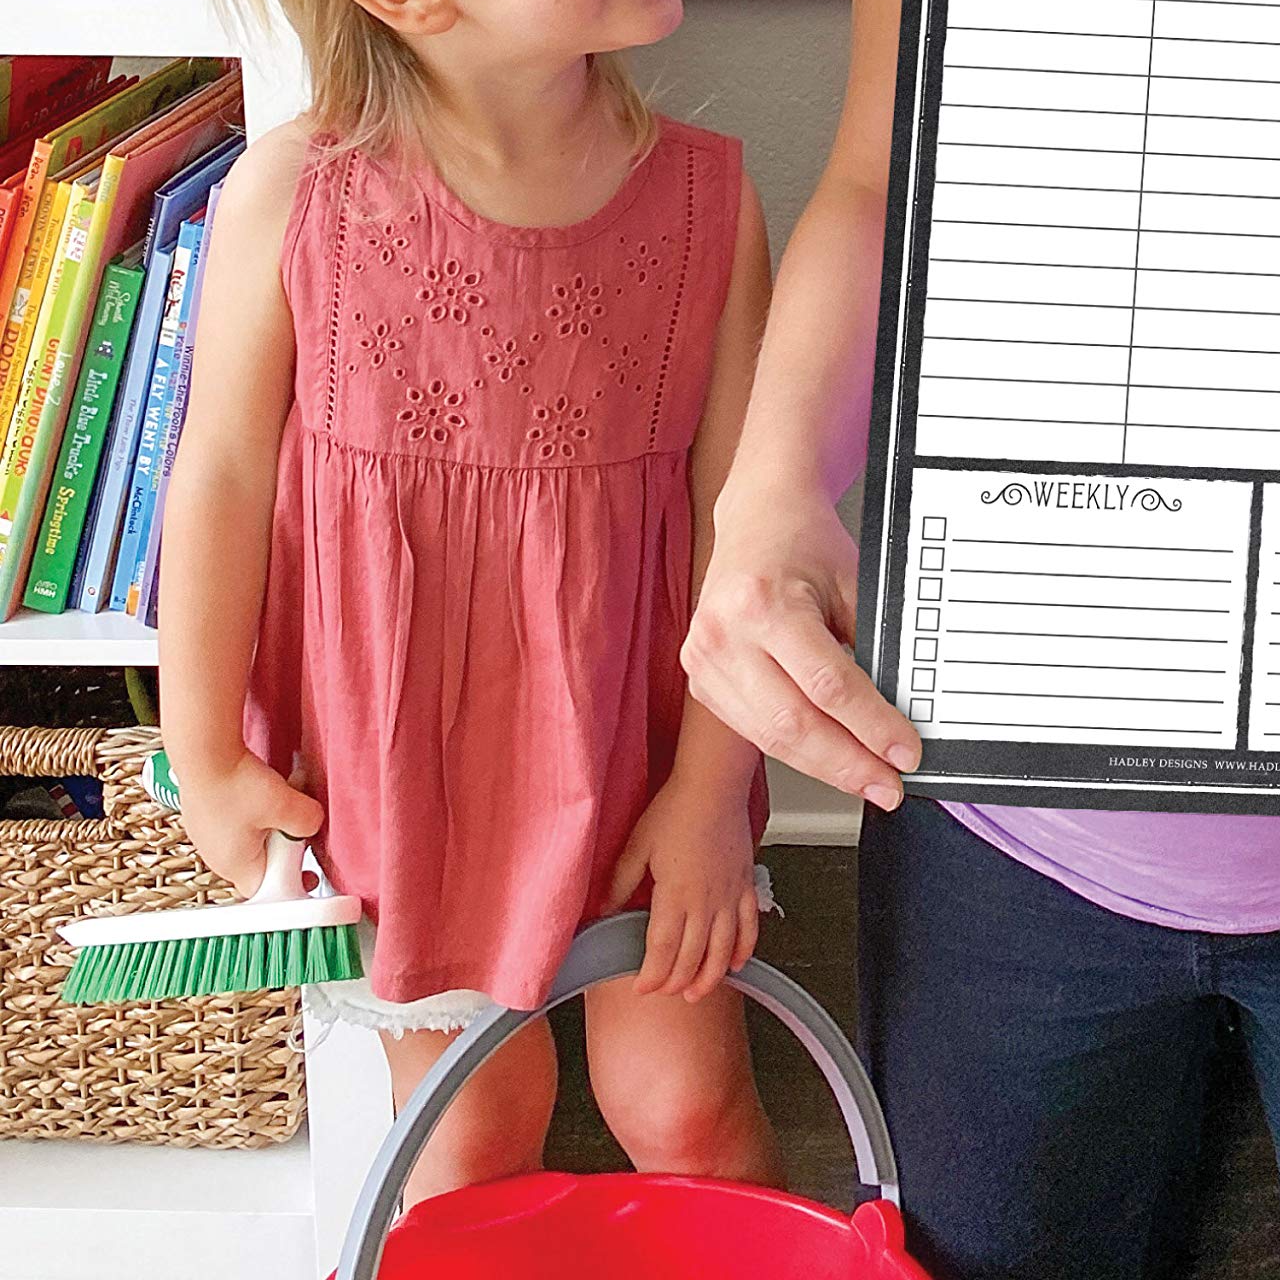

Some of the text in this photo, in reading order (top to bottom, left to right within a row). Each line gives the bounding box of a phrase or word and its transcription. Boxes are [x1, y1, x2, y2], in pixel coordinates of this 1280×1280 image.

[155, 357, 169, 369] A
[151, 374, 168, 400] FLY
[142, 406, 161, 451] WENT
[45, 369, 108, 555] Little Blue Truck's Springtime
[137, 455, 152, 476] BY
[1034, 482, 1129, 511] WEEKLY
[1108, 757, 1156, 768] HADLEY
[1159, 758, 1208, 770] DESIGNS
